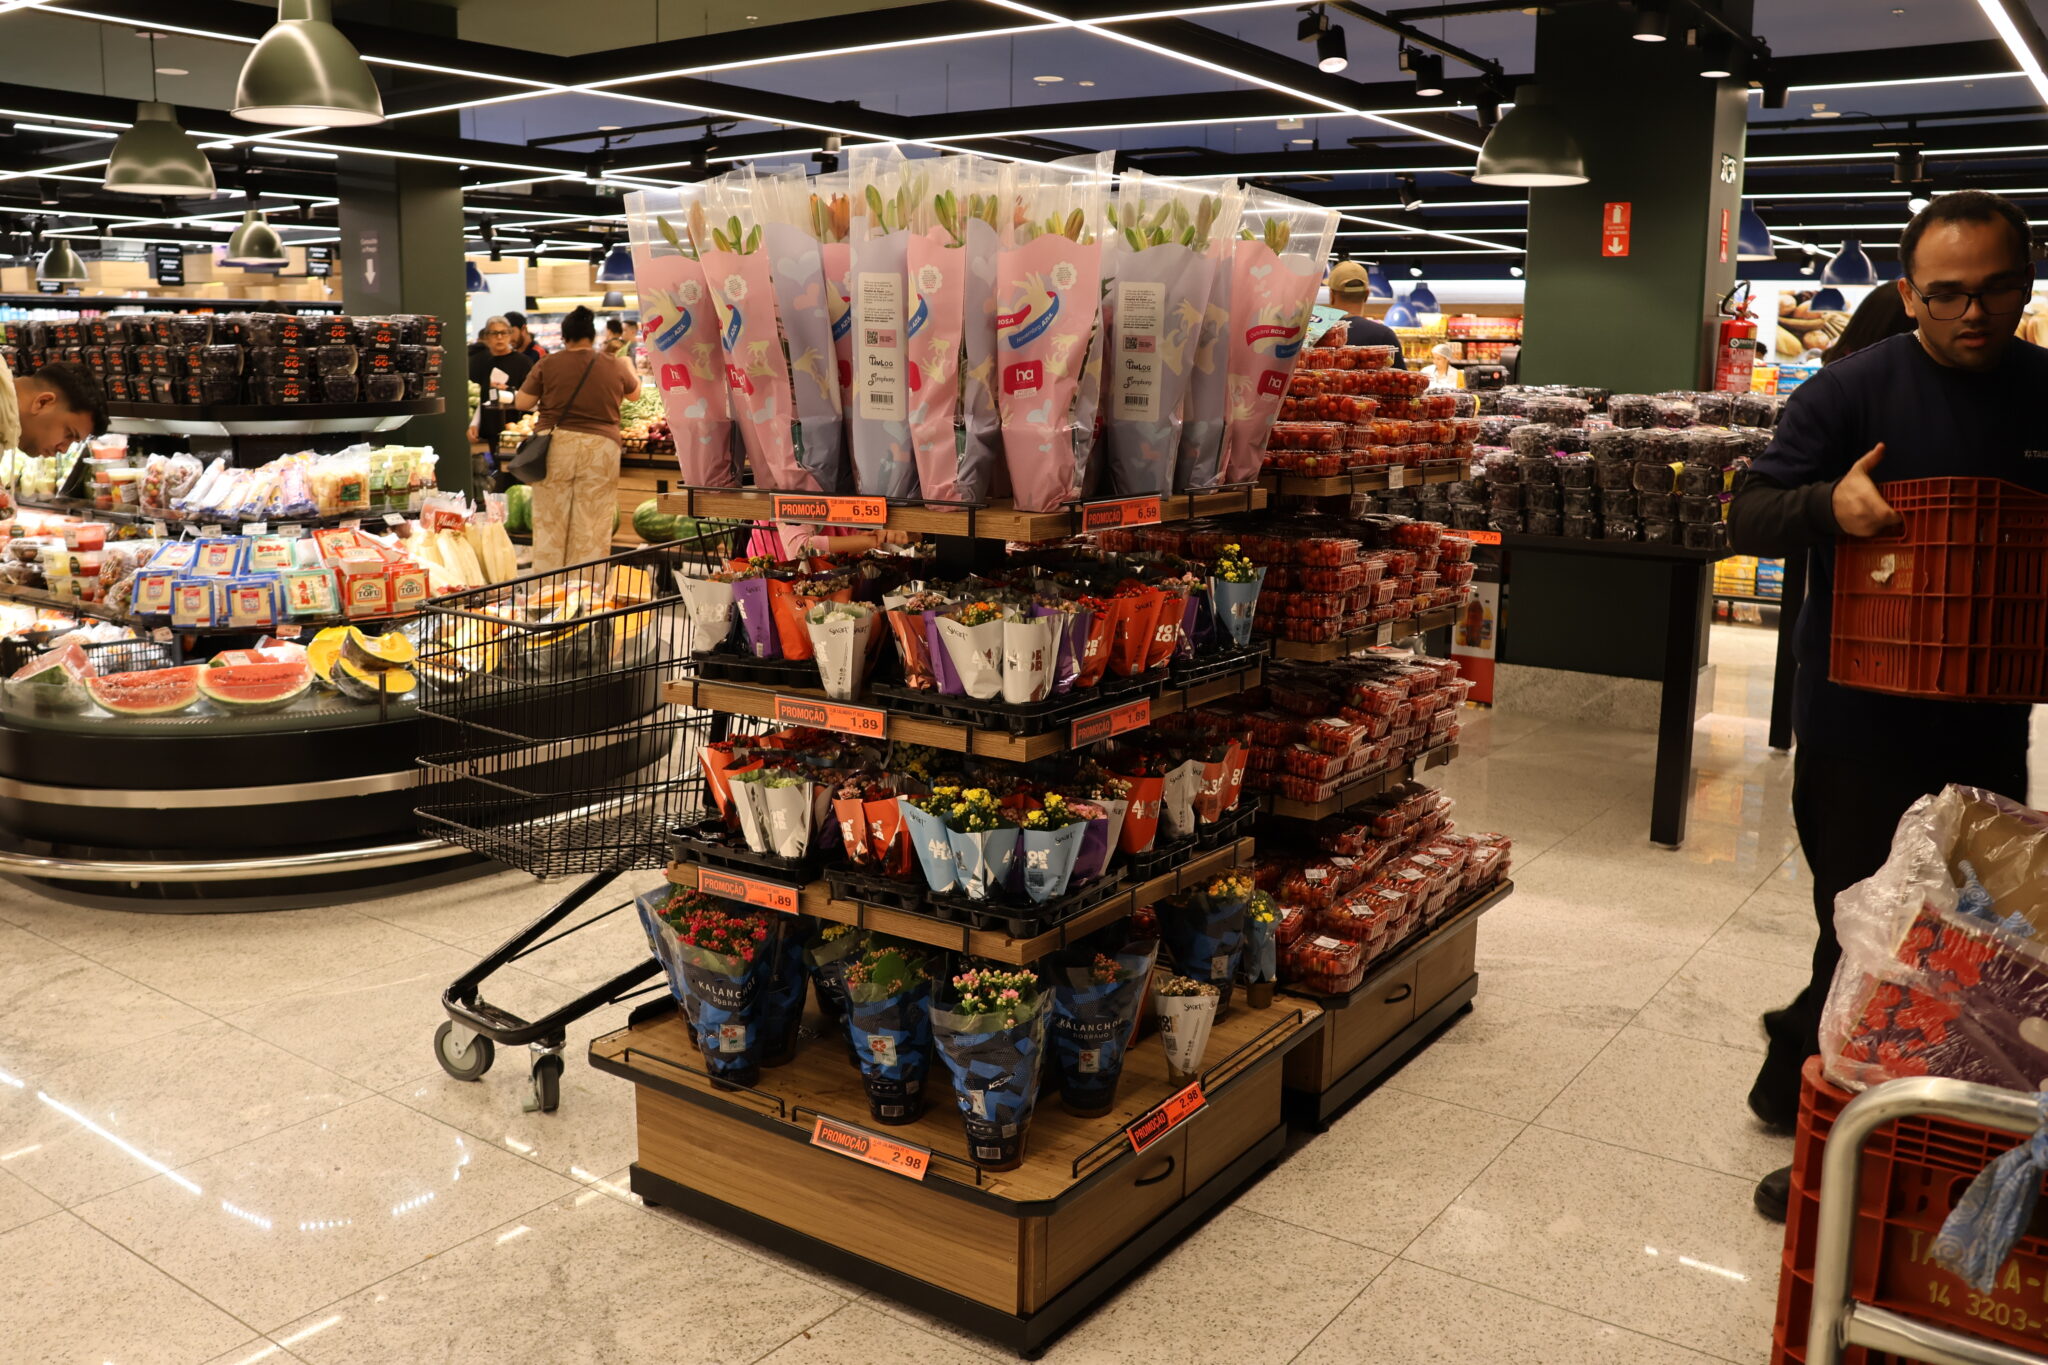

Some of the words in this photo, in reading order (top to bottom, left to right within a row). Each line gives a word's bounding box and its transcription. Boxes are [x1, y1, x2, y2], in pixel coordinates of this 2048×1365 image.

[1016, 368, 1034, 381] ha
[781, 502, 827, 518] PROMOÇÃO
[852, 505, 880, 517] 6,59
[1088, 509, 1121, 525] PROMOÇÃO
[357, 590, 380, 599] TOFU
[400, 586, 421, 595] TOFU
[781, 705, 825, 723] PROMOÇÃO
[704, 878, 744, 896] PROMOÇÃO
[1134, 1112, 1166, 1142] PROMOÇÃO
[821, 1127, 867, 1152] PROMOÇÃO
[1928, 1280, 1950, 1307] 14
[1966, 1293, 2048, 1338] 3203-
